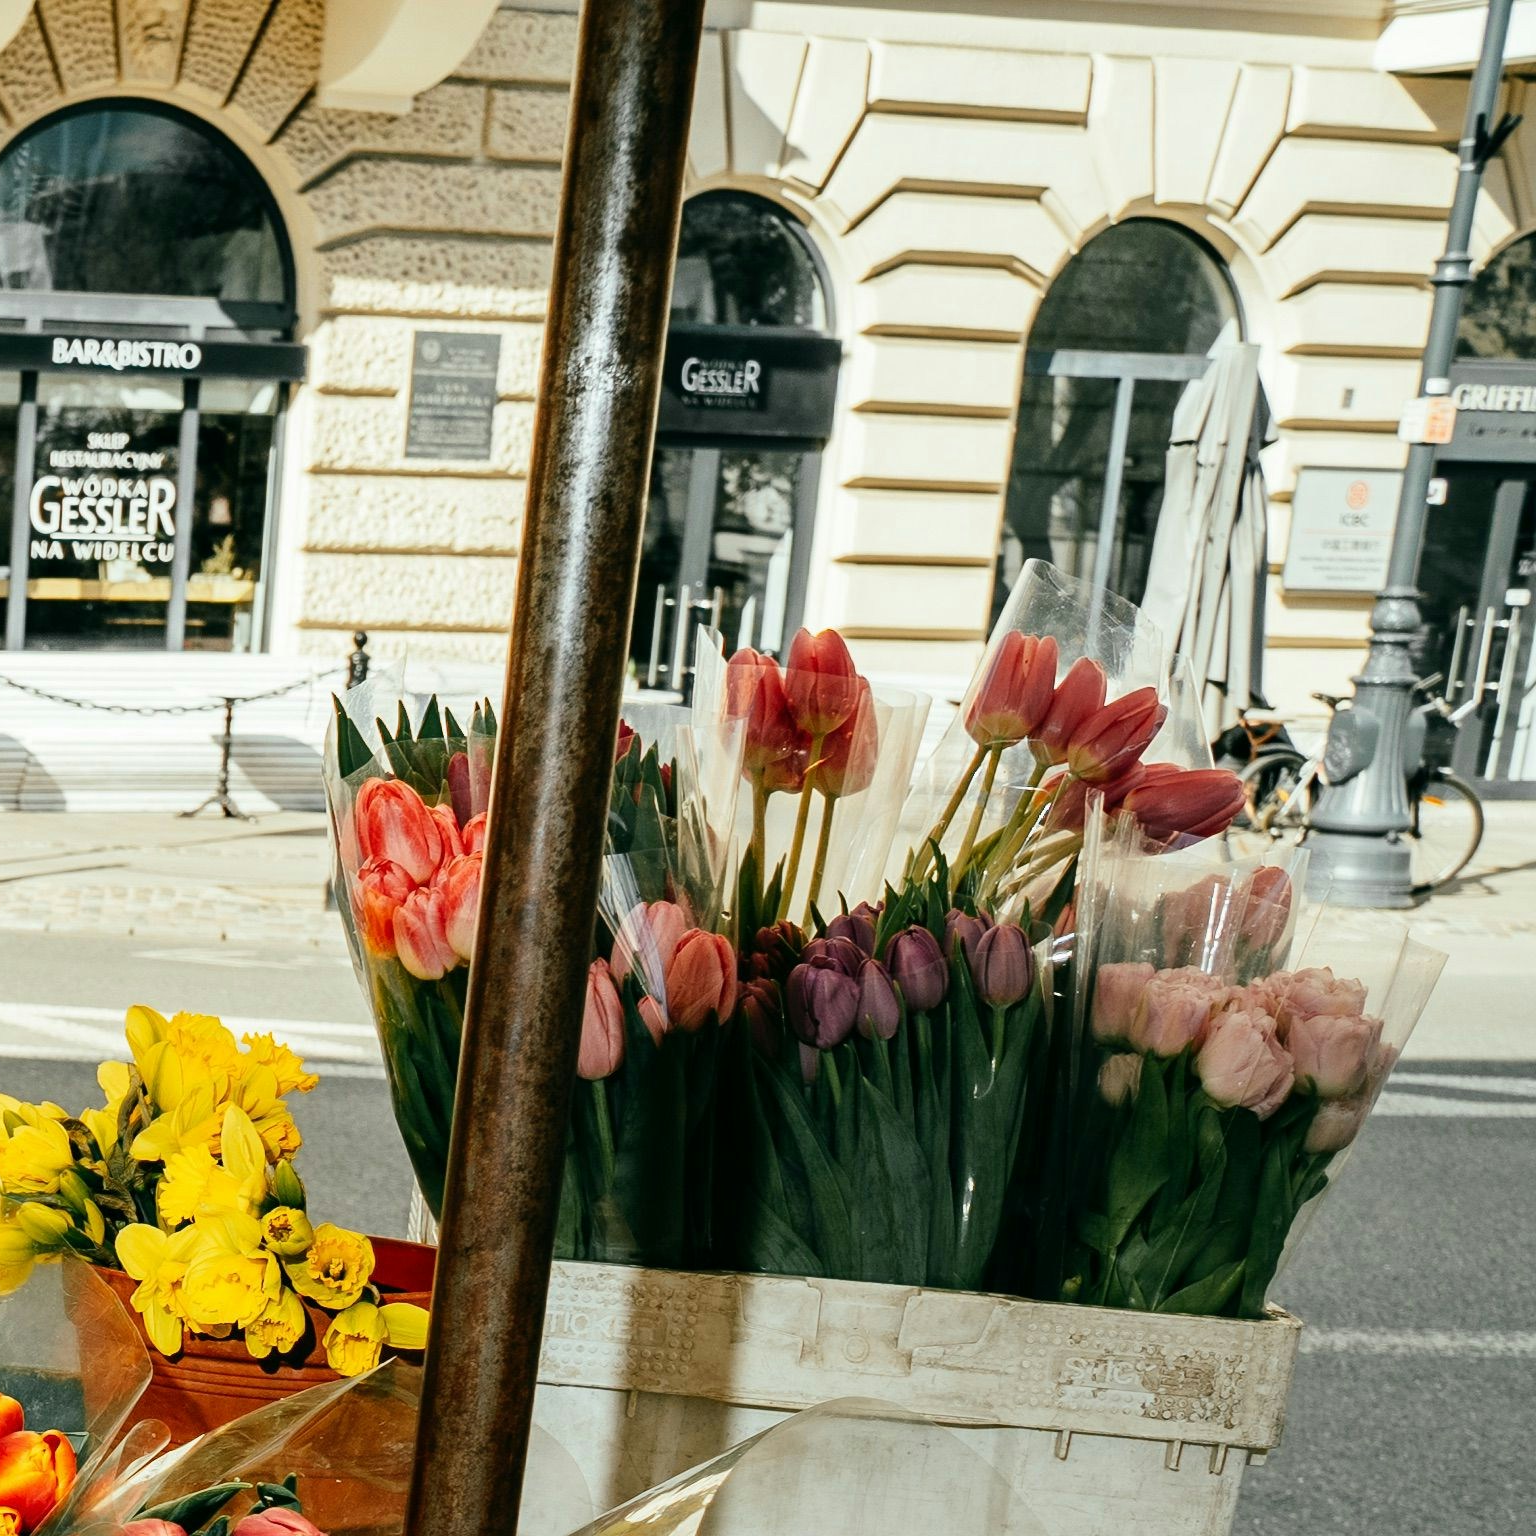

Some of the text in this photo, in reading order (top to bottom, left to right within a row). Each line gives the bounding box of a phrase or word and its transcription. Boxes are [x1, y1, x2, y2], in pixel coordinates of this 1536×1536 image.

[52, 337, 202, 371] BAR&BISTRO
[681, 357, 761, 394] GESSLER
[87, 432, 130, 450] SKLEP
[49, 450, 165, 471] RESTAURACYJNY
[61, 473, 149, 498] WÓDKA
[30, 475, 176, 536] GESSLER
[31, 540, 175, 562] NA WIDELCU
